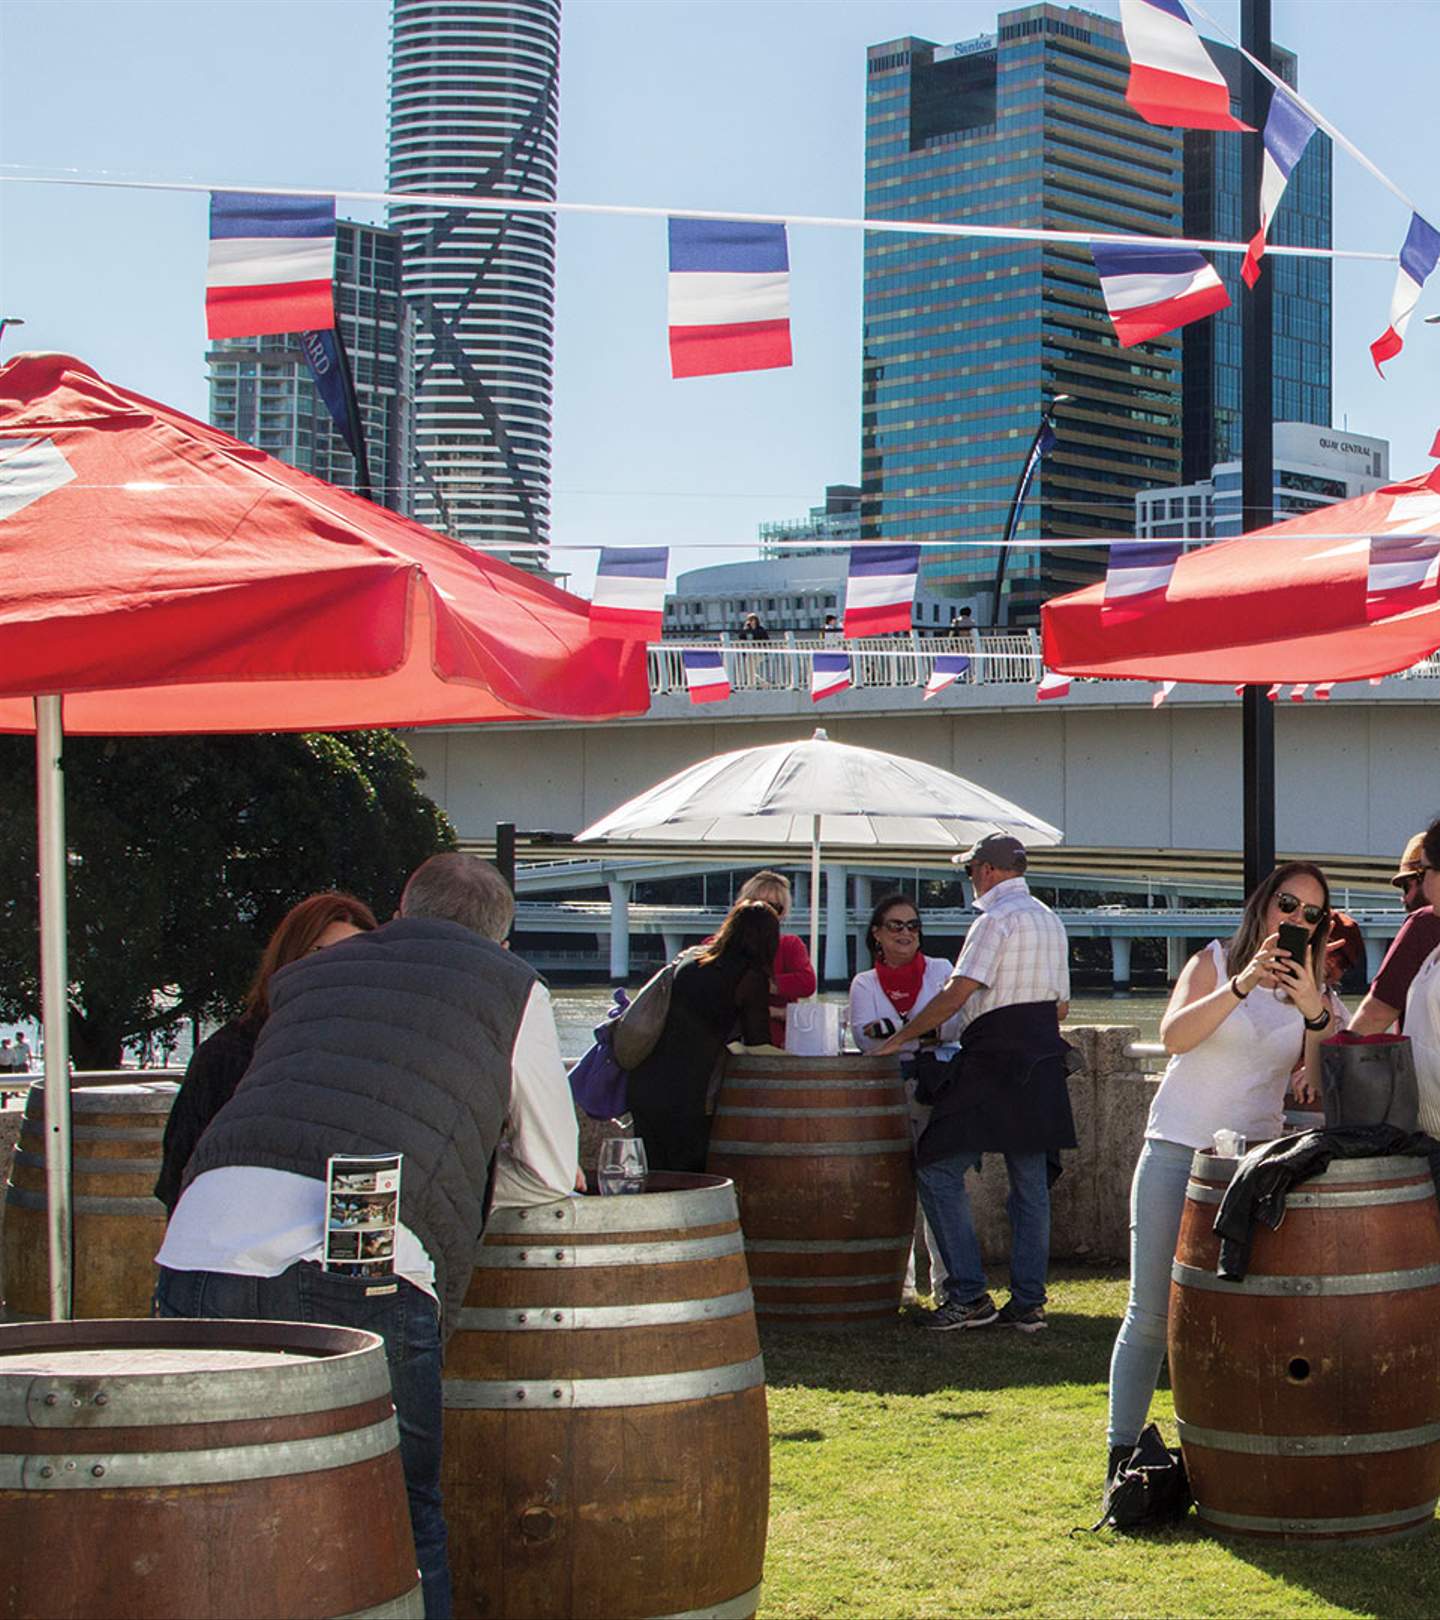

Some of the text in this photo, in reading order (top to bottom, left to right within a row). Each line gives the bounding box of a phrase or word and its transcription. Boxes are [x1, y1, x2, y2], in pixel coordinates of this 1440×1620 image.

[953, 39, 992, 56] Santos
[1319, 438, 1370, 456] QUAY CENTRAL
